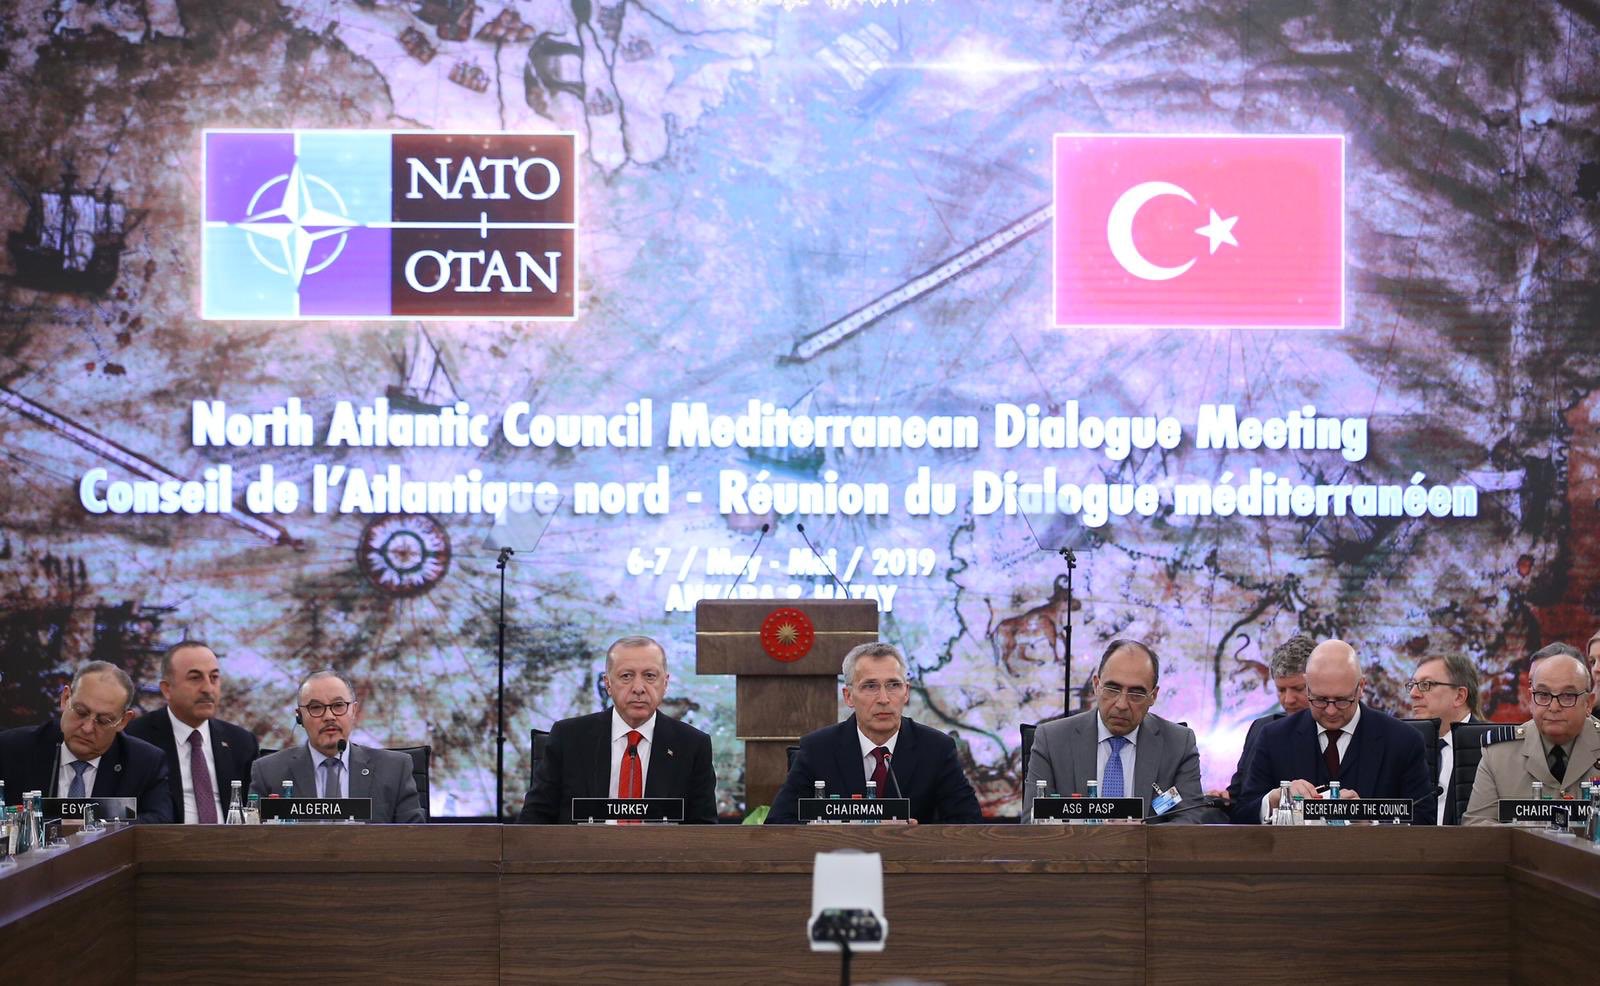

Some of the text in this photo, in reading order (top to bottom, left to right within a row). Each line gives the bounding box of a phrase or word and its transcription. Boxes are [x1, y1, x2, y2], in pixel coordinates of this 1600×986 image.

[406, 157, 561, 200] NATO
[404, 249, 562, 293] OTAN
[192, 397, 1368, 462] North Atlantic Council Mediterranean Dialogue Meeting
[79, 464, 232, 513] Conseil
[246, 464, 299, 514] de
[574, 465, 670, 515] nord
[686, 491, 702, 503] -
[719, 470, 889, 515] Réunion
[904, 466, 957, 515] du
[972, 467, 1160, 528] Dialogue
[1174, 468, 1478, 517] méditerranéen
[626, 547, 671, 576] 6-7
[677, 545, 698, 582] /
[706, 547, 763, 582] May
[788, 547, 837, 576] Mai
[843, 545, 864, 582] /
[872, 548, 936, 576] 2019
[61, 803, 93, 815] EGY
[290, 803, 342, 815] ALGERIA
[606, 804, 649, 816] TURKEY
[825, 804, 884, 816] CHAIRMAN
[1062, 803, 1115, 814] ASG PASP
[1305, 804, 1410, 816] SECRETARY OF THE COUNCIL
[1515, 805, 1572, 817] CHAIRN
